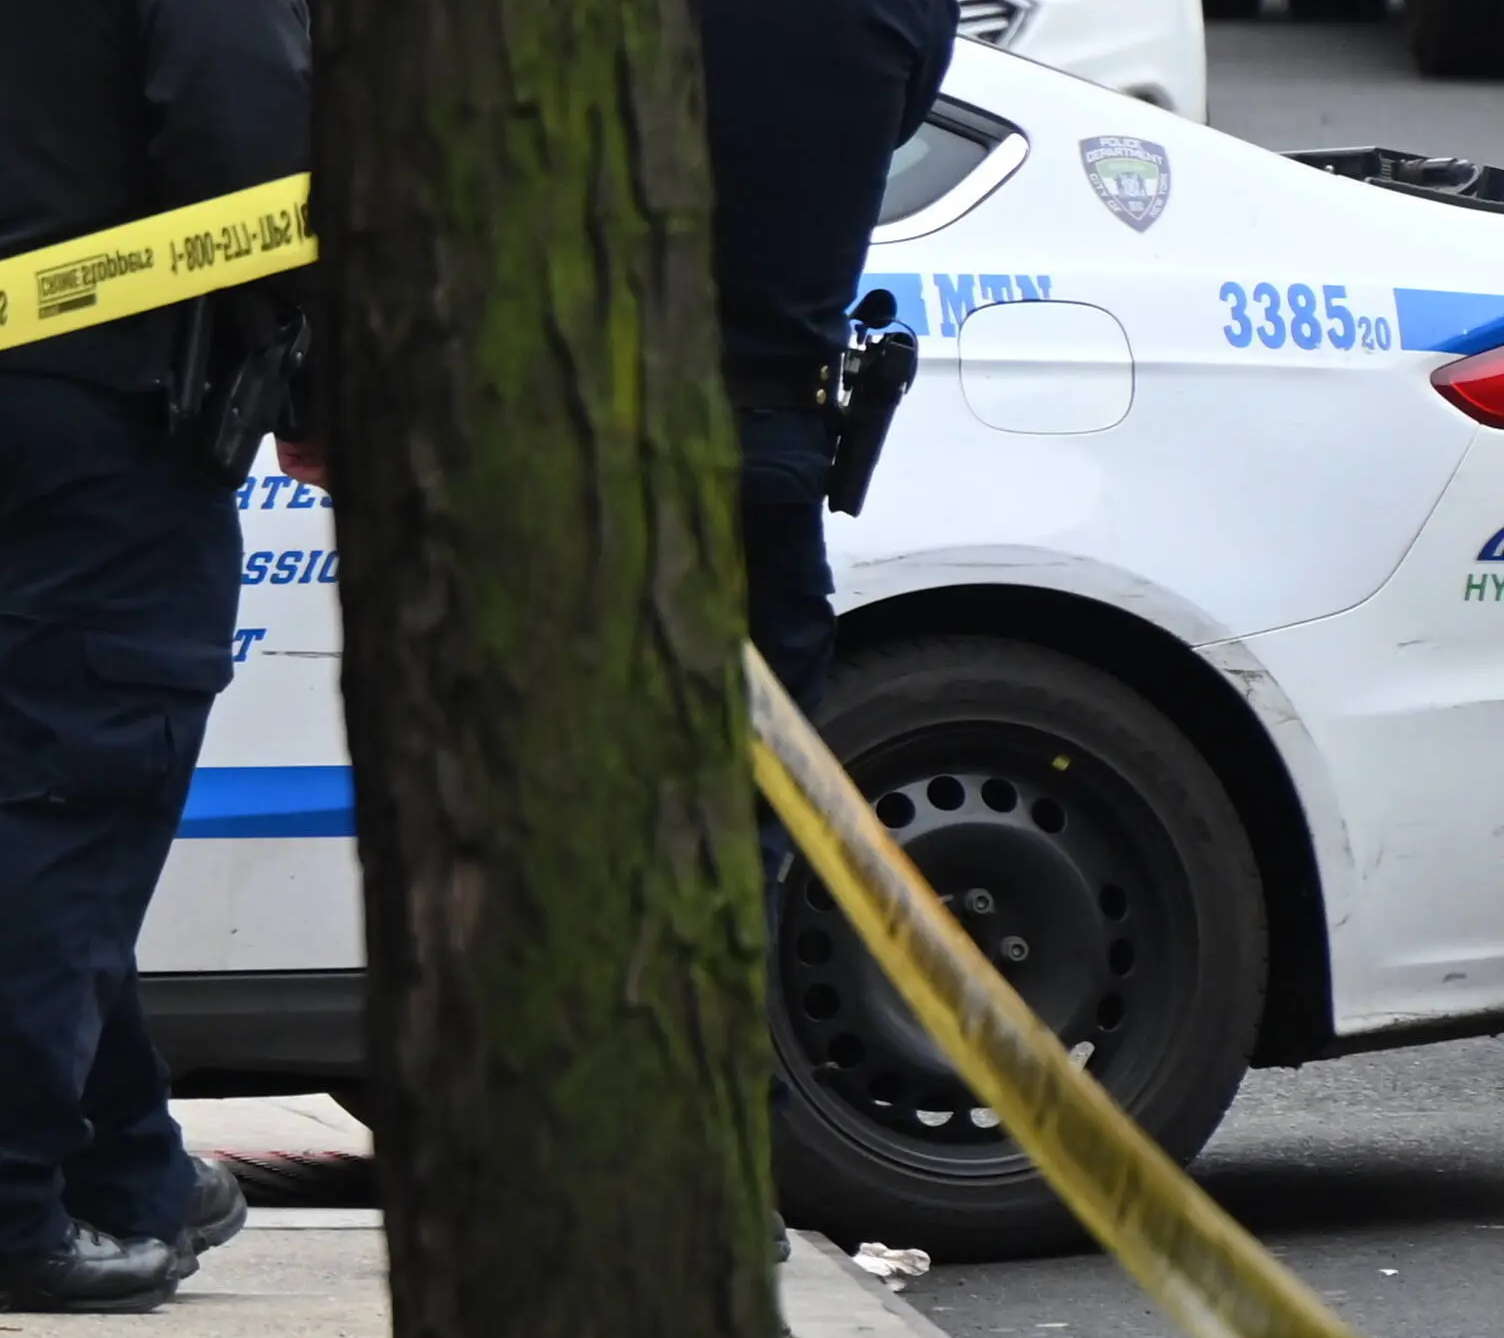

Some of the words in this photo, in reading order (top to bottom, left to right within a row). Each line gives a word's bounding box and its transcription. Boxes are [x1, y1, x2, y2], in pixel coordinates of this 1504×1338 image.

[1099, 137, 1141, 149] POLICE
[1085, 147, 1163, 166] DEPARTMENT
[1089, 172, 1109, 197] CITY
